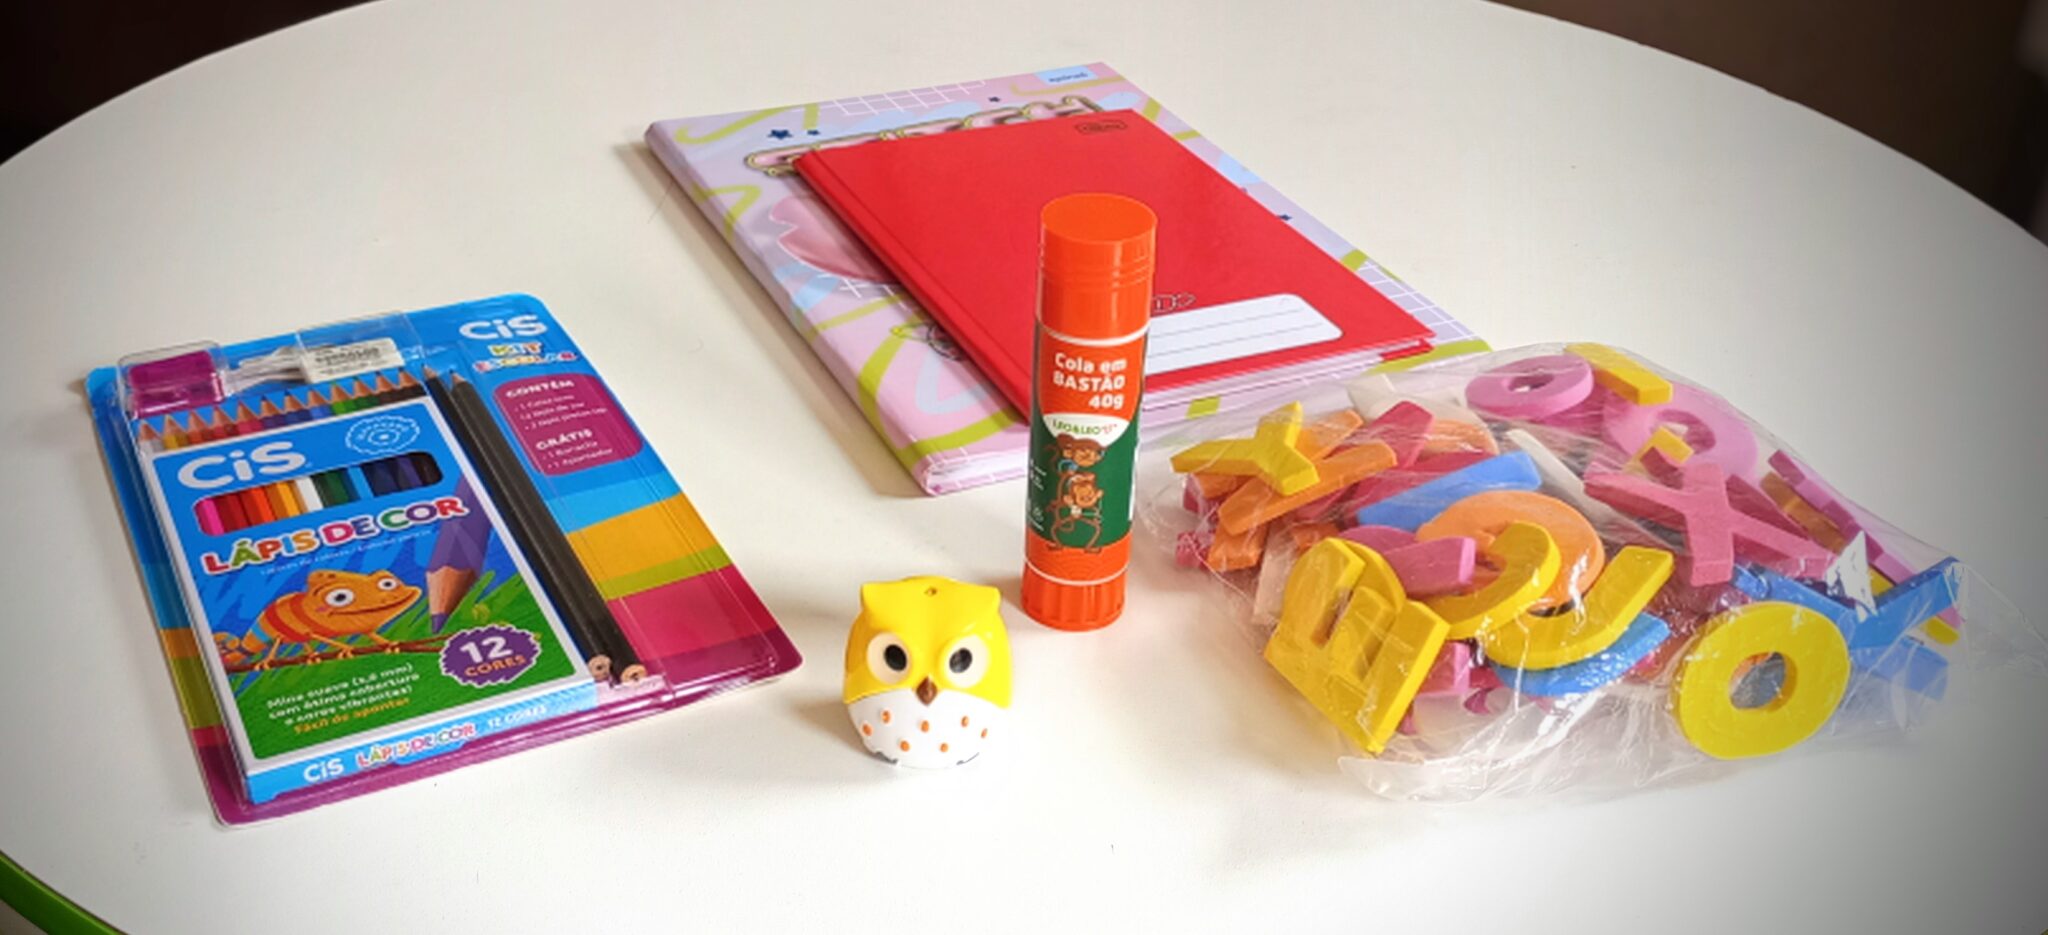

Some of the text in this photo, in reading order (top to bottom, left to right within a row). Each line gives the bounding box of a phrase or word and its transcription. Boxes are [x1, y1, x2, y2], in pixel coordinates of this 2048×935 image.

[460, 315, 547, 339] CiS
[1055, 352, 1127, 374] Cola em
[1053, 370, 1126, 392] BASTÃO
[1088, 394, 1124, 410] 40g
[177, 441, 306, 489] CiS
[202, 530, 317, 574] LÁPIS
[321, 516, 377, 545] DE
[380, 498, 467, 529] COR
[460, 636, 513, 663] 12
[464, 654, 527, 677] CORES
[303, 757, 344, 782] CiS
